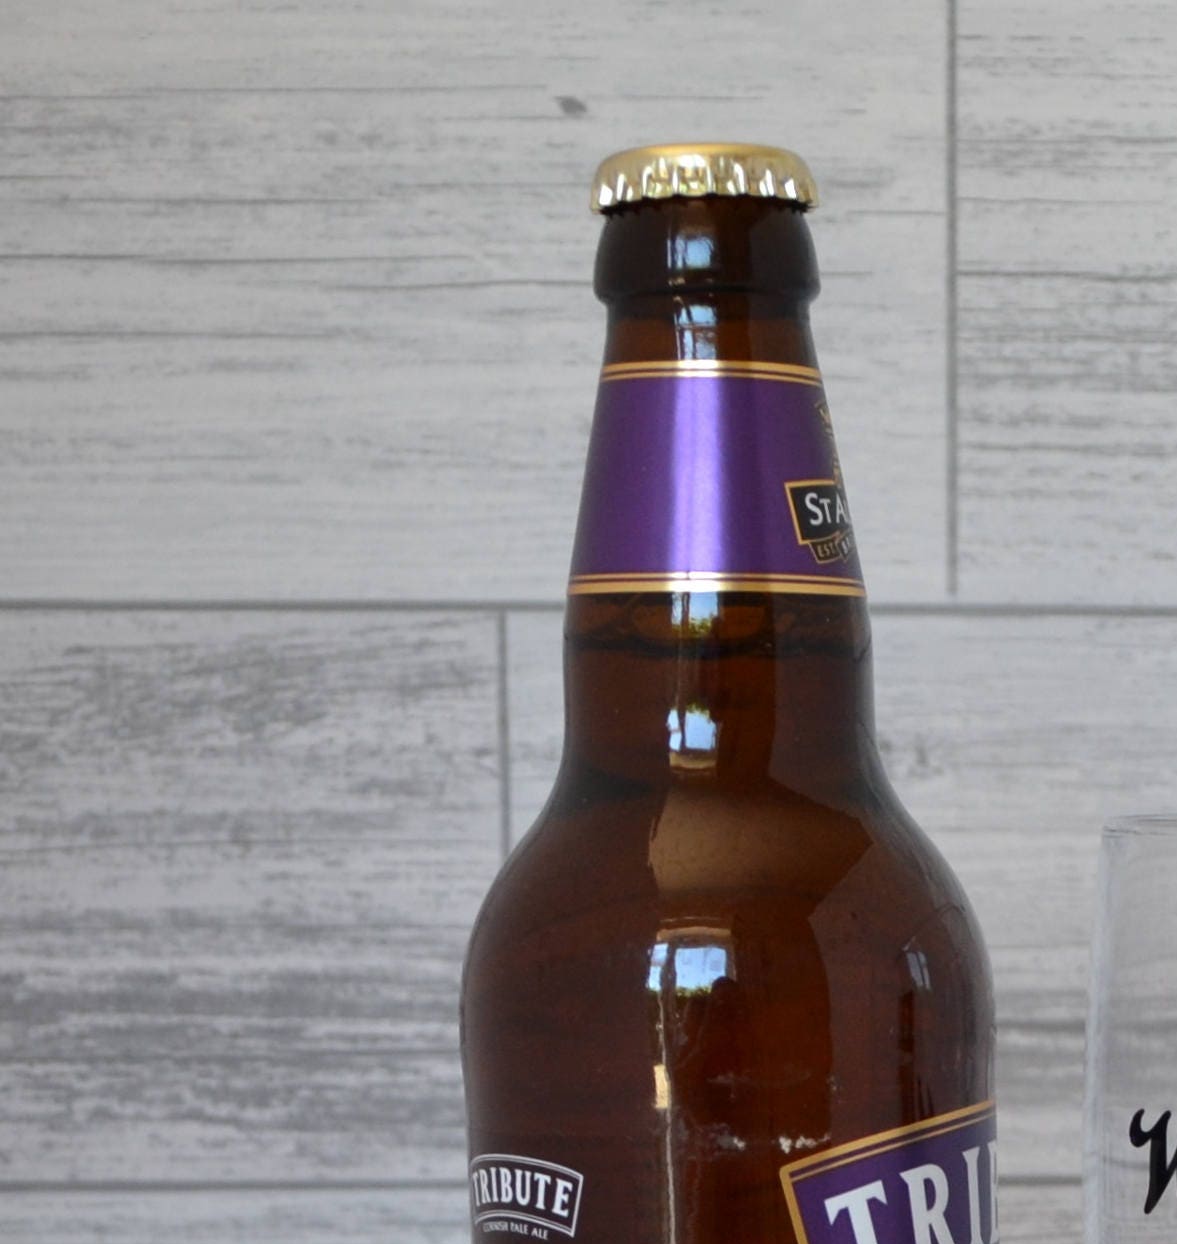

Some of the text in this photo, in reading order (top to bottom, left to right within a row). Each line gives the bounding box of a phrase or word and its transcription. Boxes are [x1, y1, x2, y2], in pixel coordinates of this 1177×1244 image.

[472, 1166, 574, 1218] TRIBUTE
[510, 1221, 529, 1236] PALE
[531, 1225, 549, 1241] ALE
